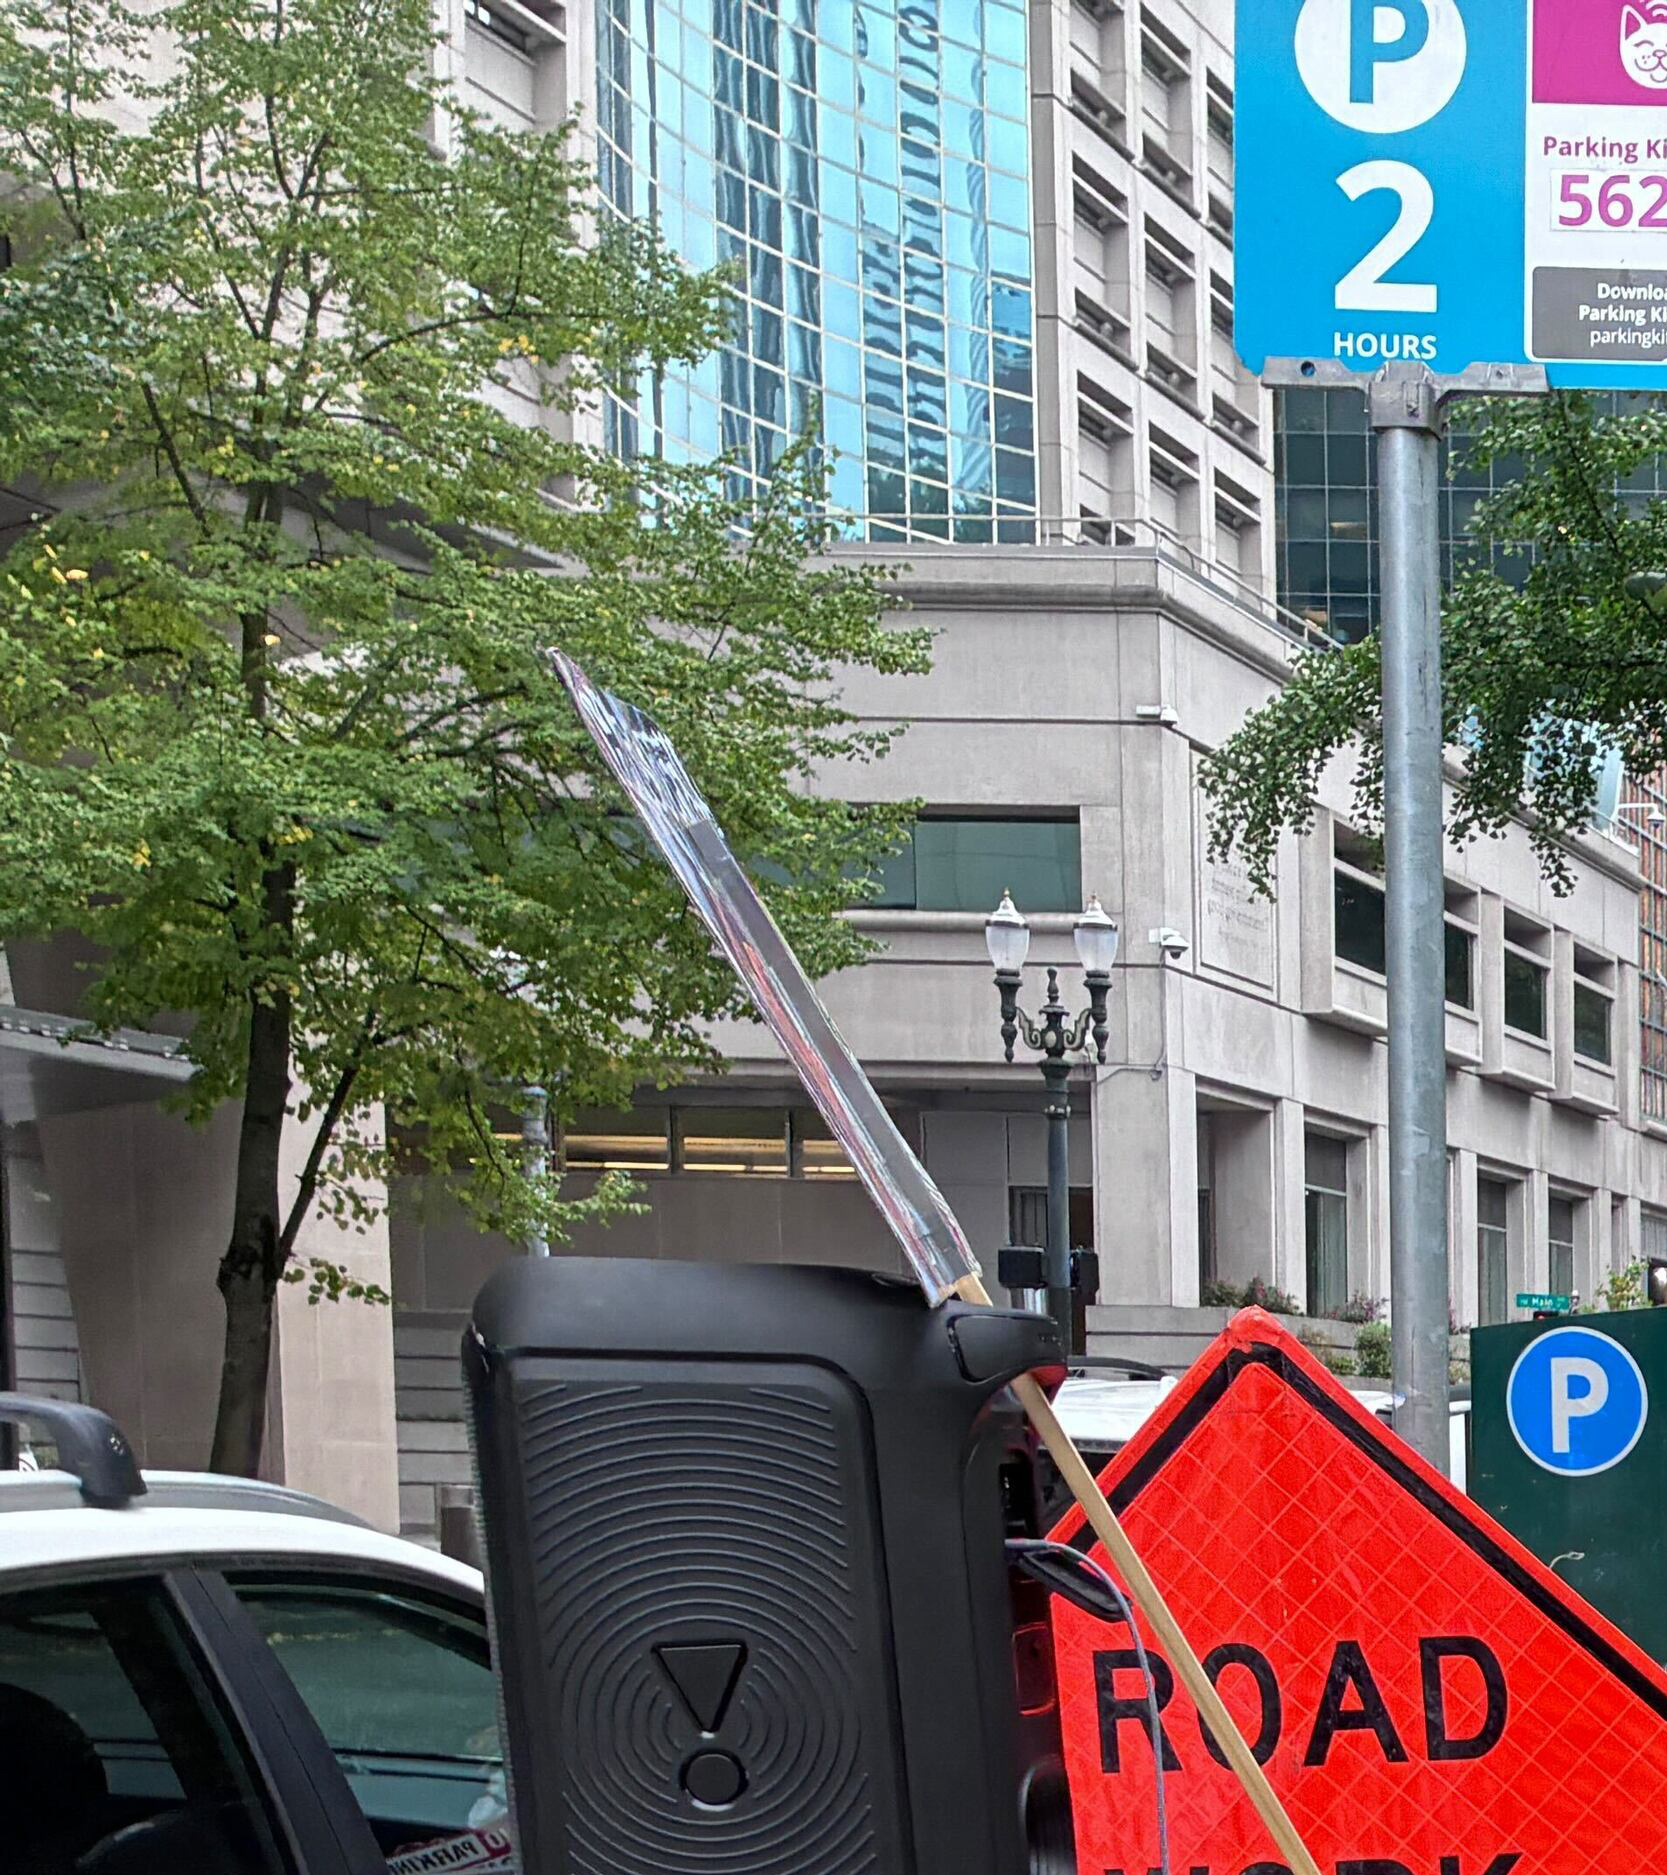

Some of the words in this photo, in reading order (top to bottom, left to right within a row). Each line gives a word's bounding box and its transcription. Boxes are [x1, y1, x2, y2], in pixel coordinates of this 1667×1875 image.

[1350, 0, 1429, 104] P
[1543, 136, 1638, 163] Parking
[1334, 160, 1438, 313] 2
[1333, 331, 1438, 360] HOURS
[1579, 304, 1647, 326] Parking
[1550, 1356, 1610, 1454] P
[1092, 1635, 1509, 1775] ROAD
